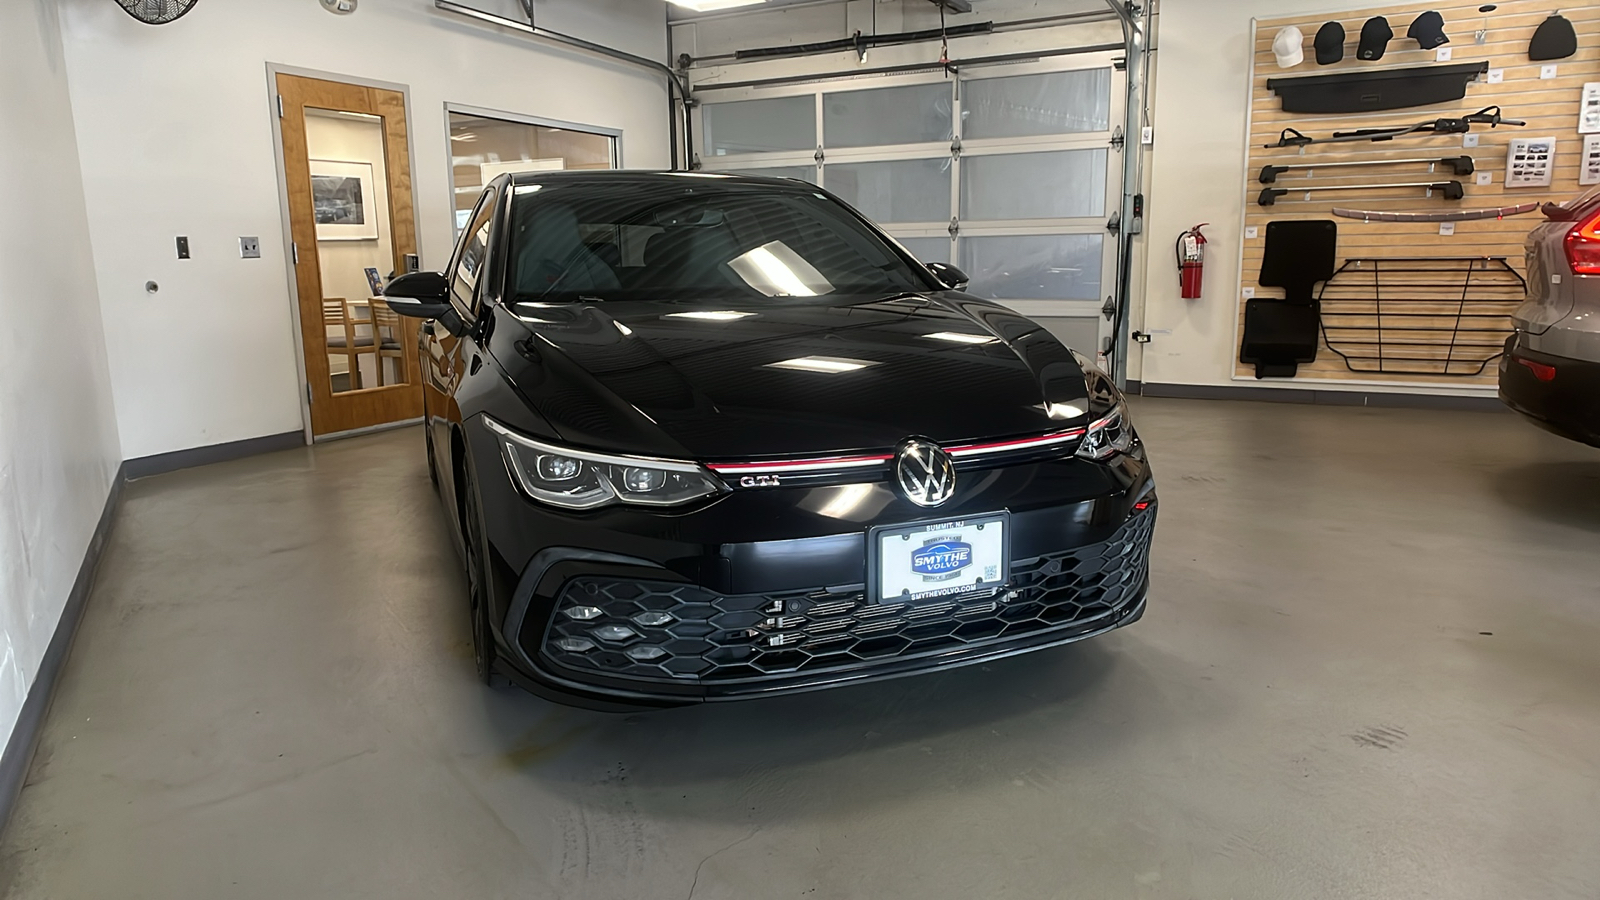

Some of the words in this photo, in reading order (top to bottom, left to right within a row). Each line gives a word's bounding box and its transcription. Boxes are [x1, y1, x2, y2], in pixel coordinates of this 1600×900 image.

[739, 474, 780, 488] GTI
[914, 551, 968, 567] SMYTHE
[927, 560, 959, 571] VOLVO
[911, 584, 977, 601] SMYTHEVOLVO.COM
